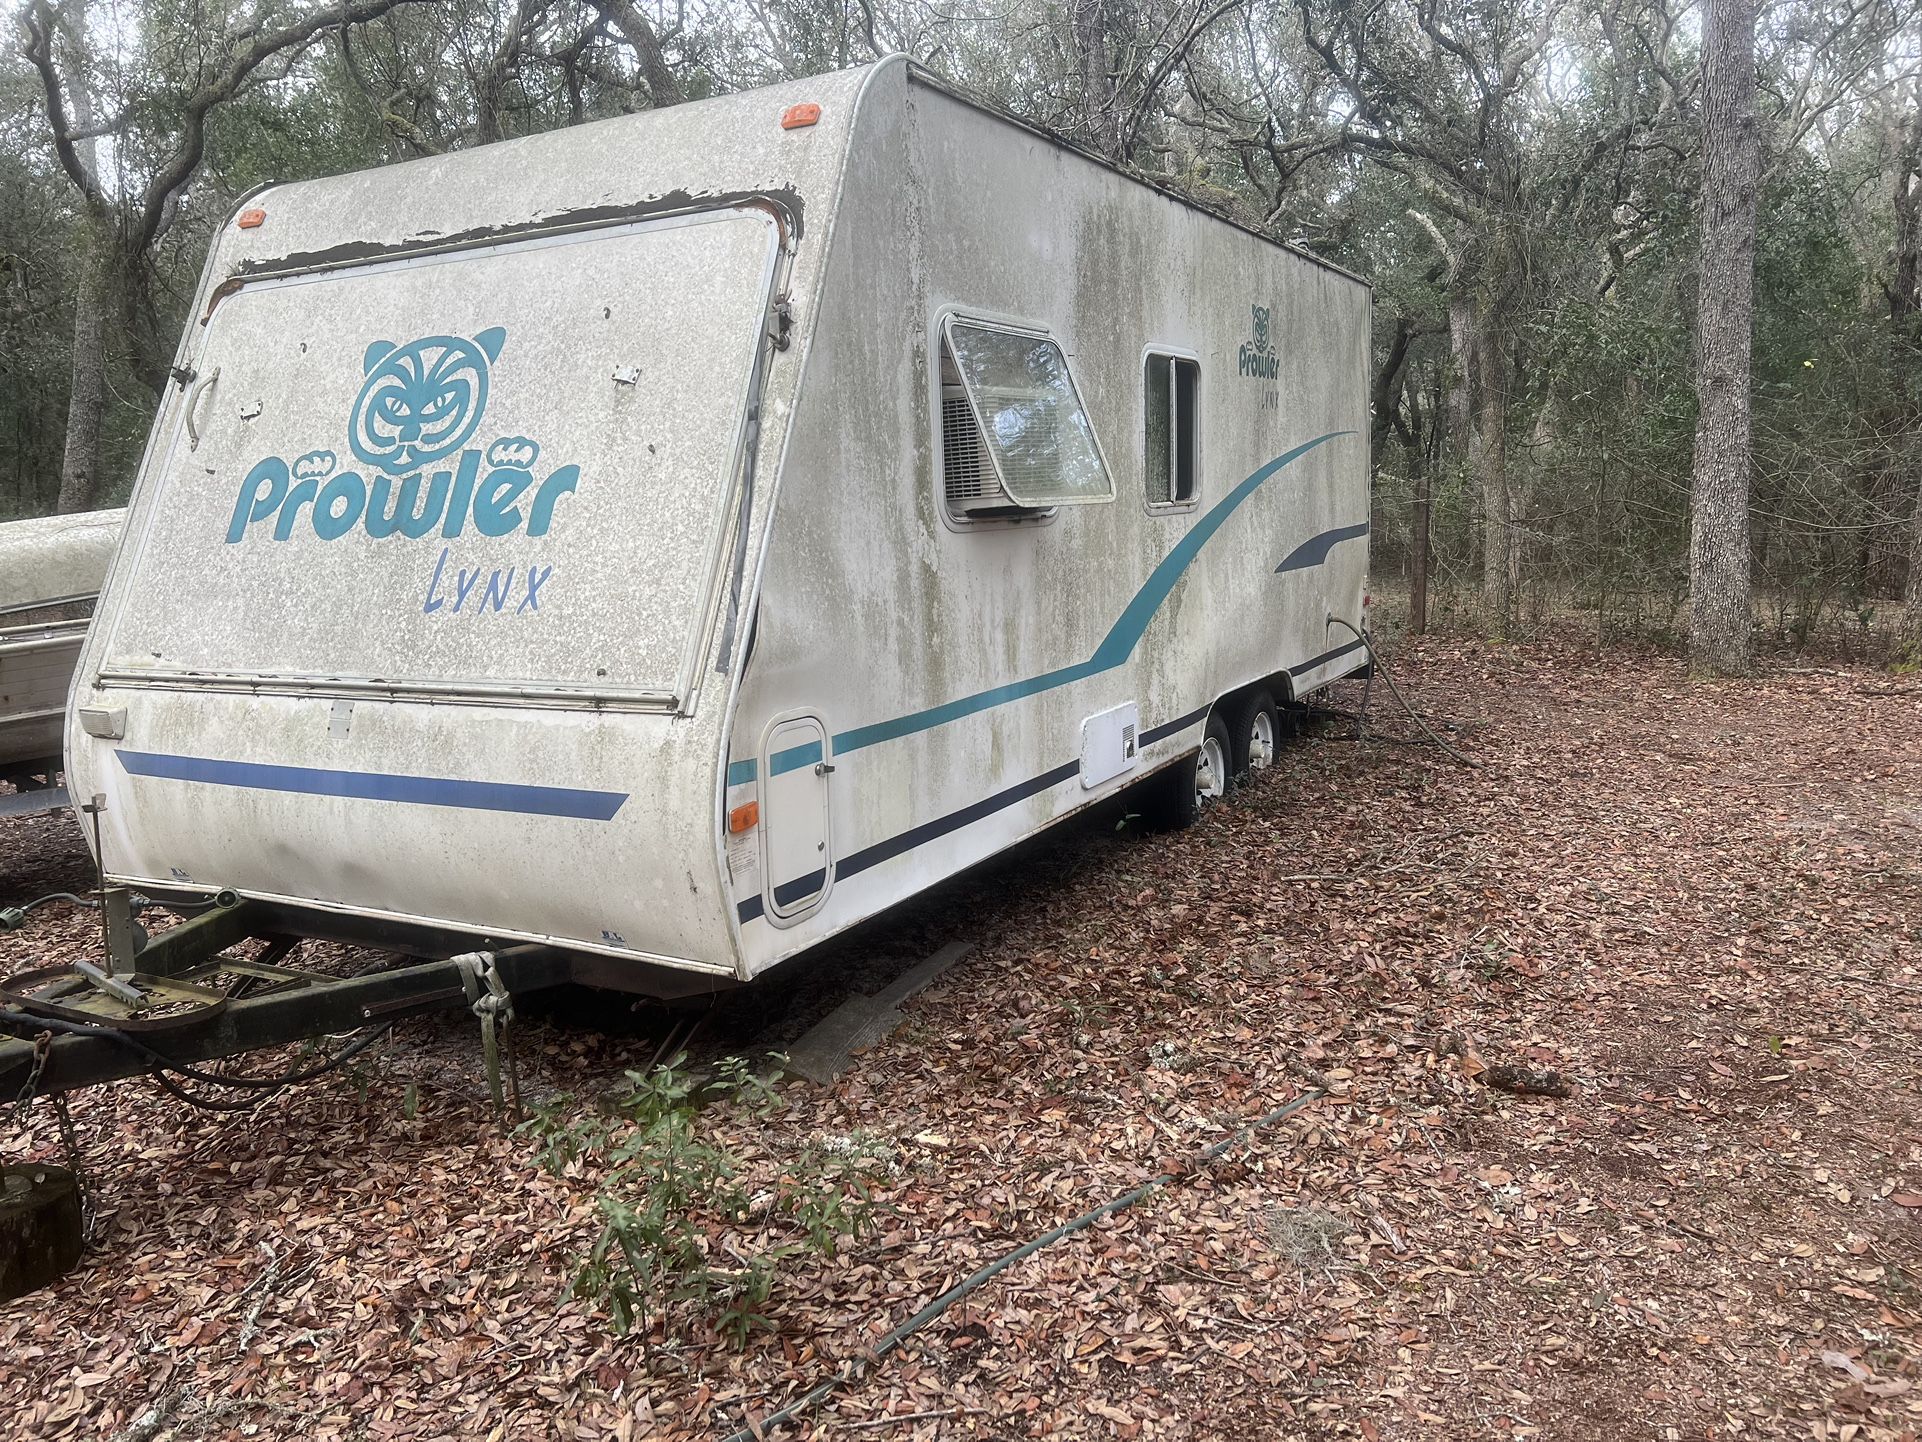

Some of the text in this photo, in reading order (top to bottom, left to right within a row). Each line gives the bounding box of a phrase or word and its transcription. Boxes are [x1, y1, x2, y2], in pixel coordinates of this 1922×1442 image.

[1238, 344, 1280, 381] Prowler
[225, 449, 581, 544] Prowler
[423, 547, 552, 615] LYNX
